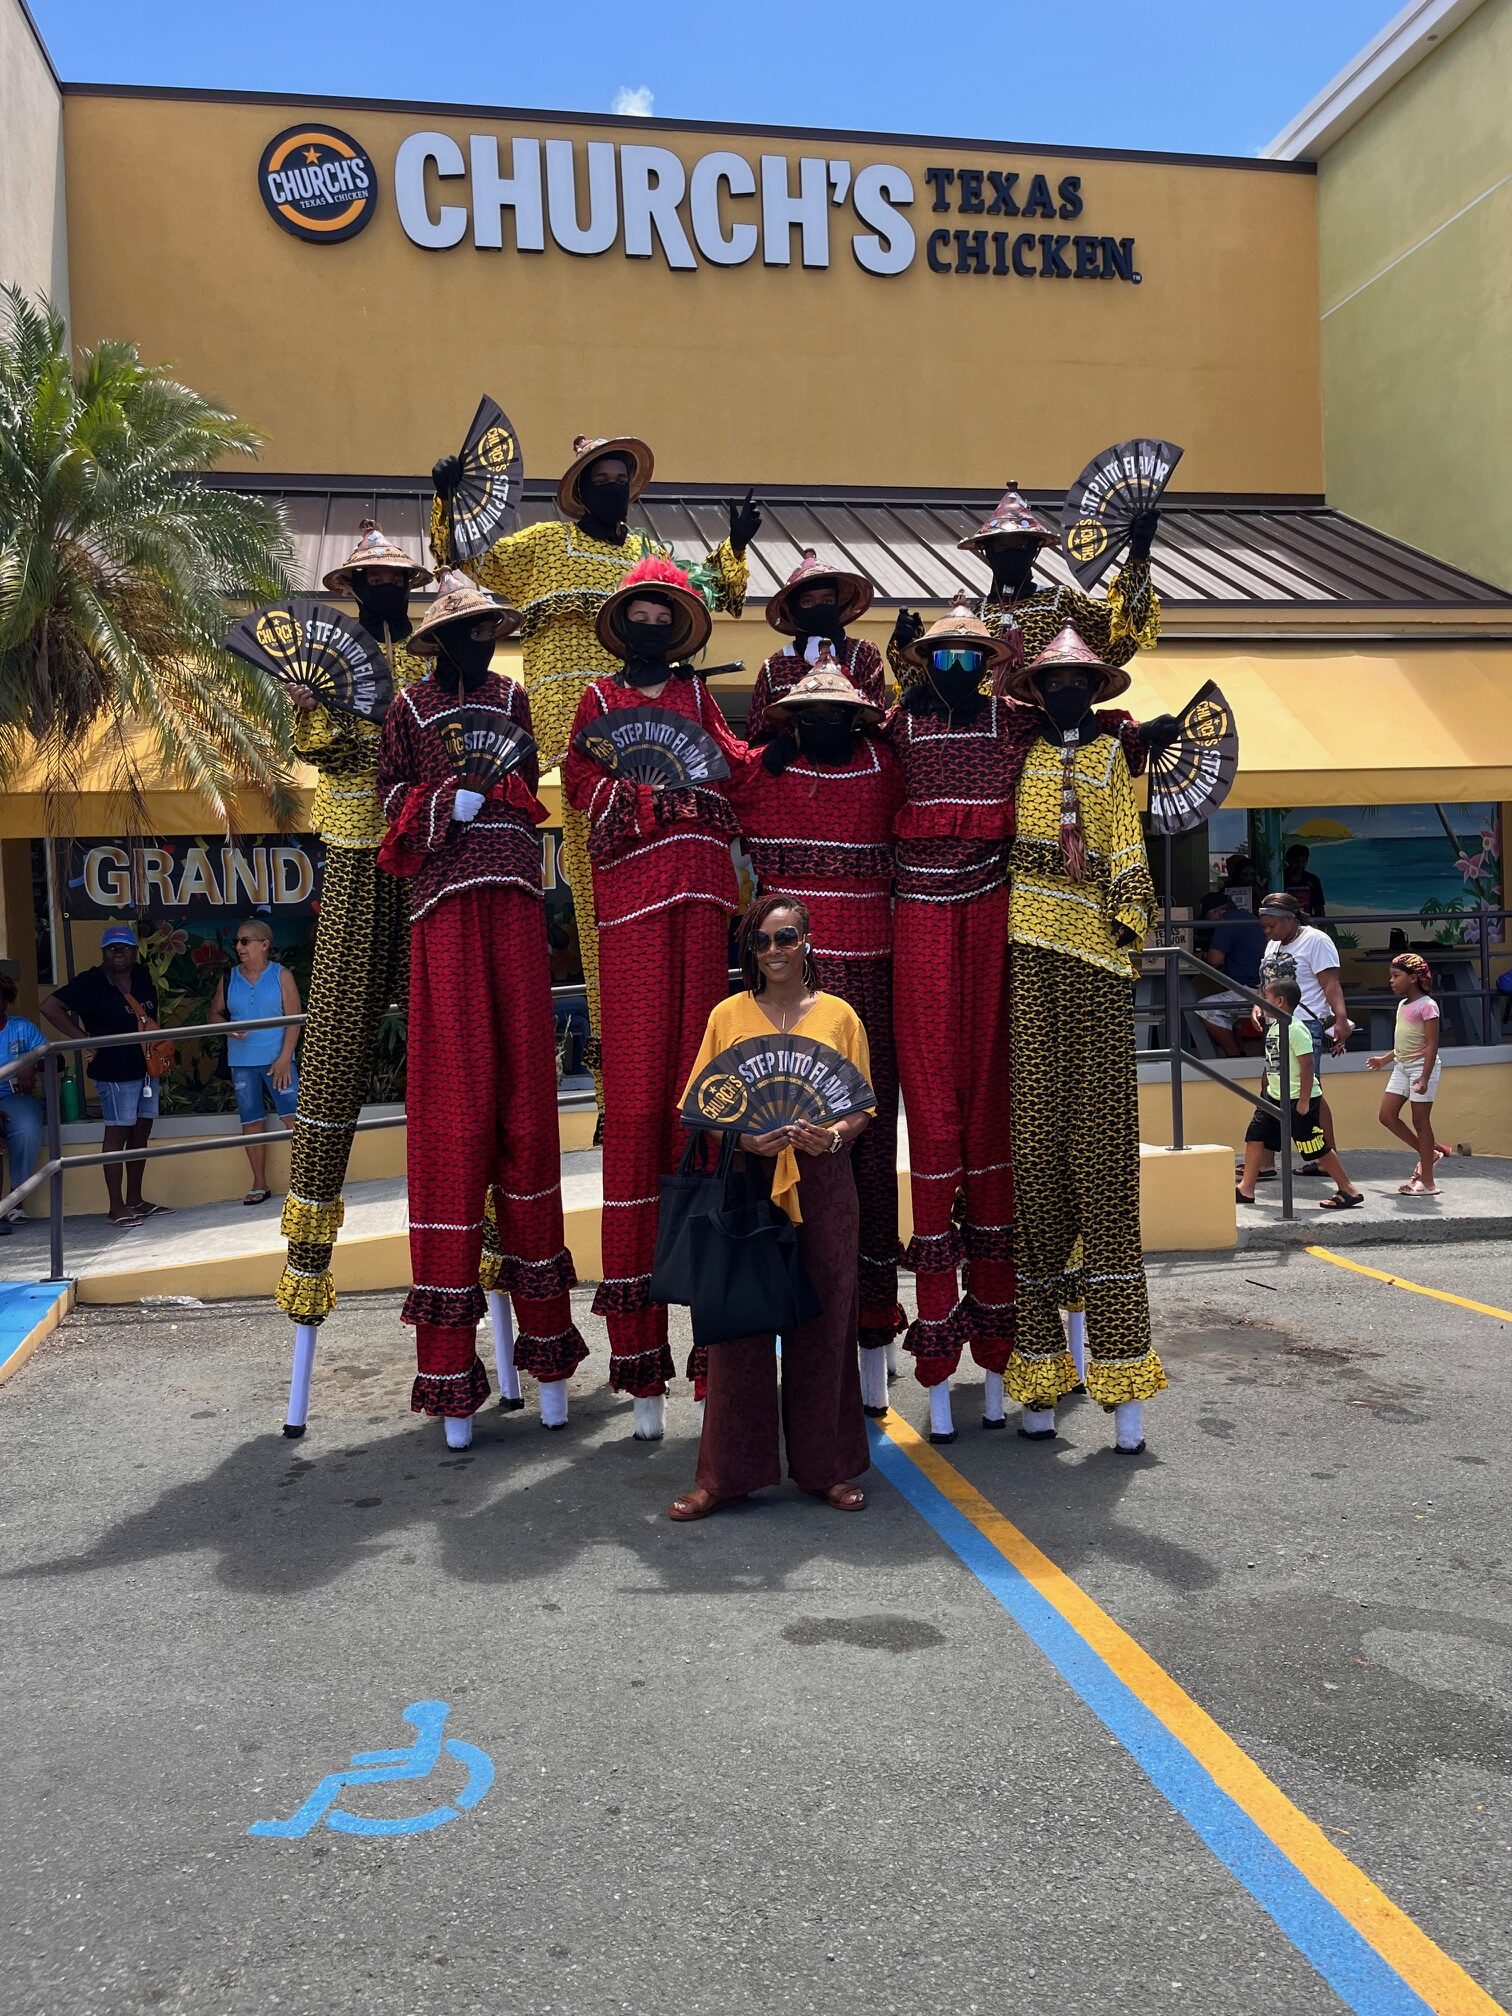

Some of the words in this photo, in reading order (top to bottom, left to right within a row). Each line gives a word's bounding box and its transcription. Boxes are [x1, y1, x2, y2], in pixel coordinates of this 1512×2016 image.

[267, 157, 370, 204] CHURCH'S
[300, 197, 327, 209] TEXAS
[334, 189, 369, 203] CHICKEN
[394, 131, 916, 277] CHURCH'S
[925, 167, 1084, 221] TEXAS
[927, 229, 1136, 282] CHICKEN
[463, 730, 496, 751] STEP
[611, 721, 643, 750] STEP
[644, 721, 677, 746] INTO
[670, 732, 709, 781] FLAVOR
[84, 846, 314, 906] GRAND
[738, 1052, 775, 1083] STEP
[777, 1050, 814, 1077] INTO
[808, 1061, 852, 1114] FLAVOR
